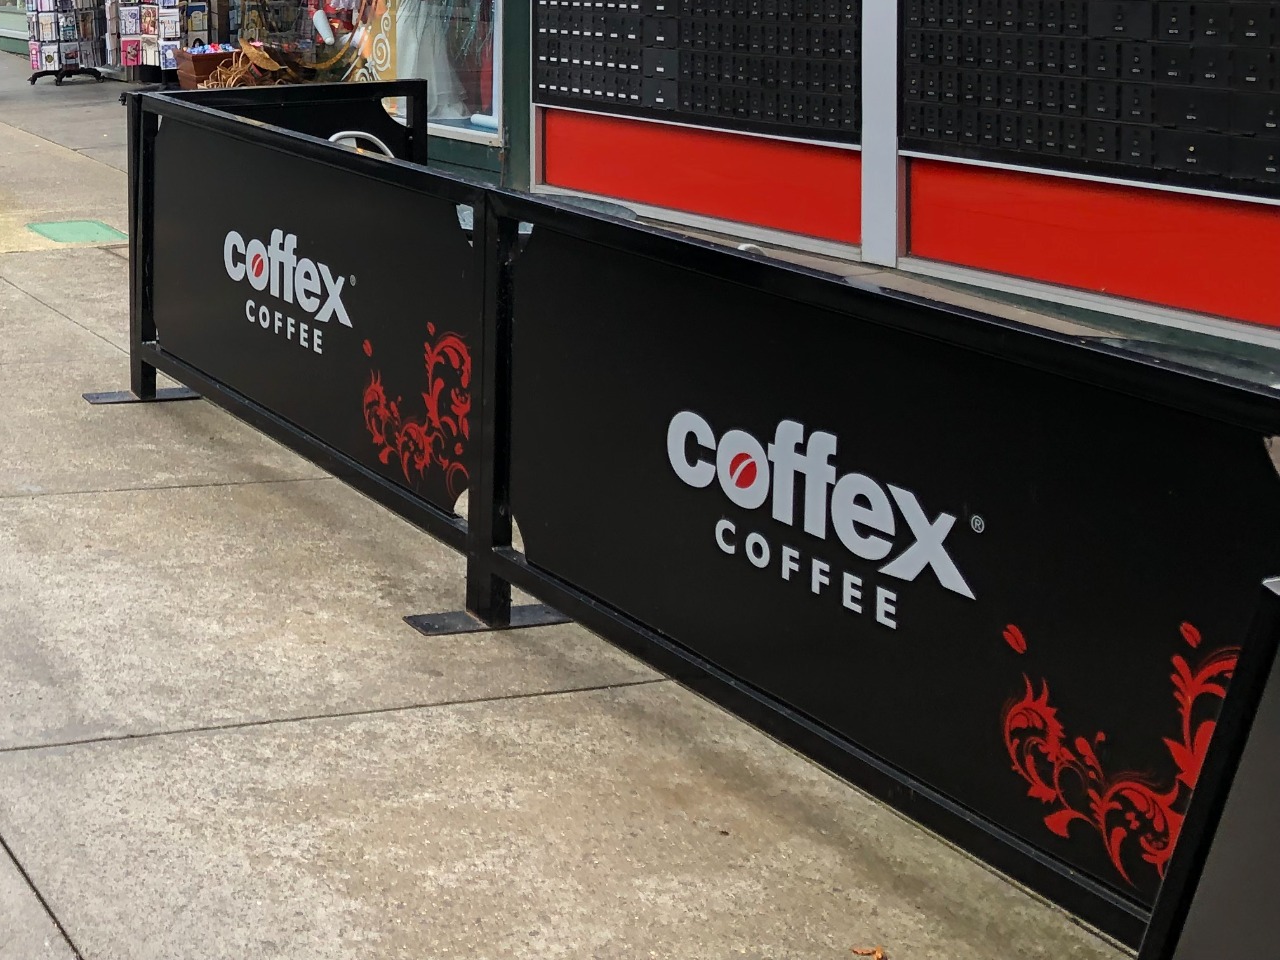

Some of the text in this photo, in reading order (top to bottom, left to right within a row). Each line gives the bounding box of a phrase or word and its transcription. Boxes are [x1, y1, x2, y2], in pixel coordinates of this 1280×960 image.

[224, 228, 353, 328] coffex
[245, 299, 324, 355] COFFEE
[667, 411, 977, 601] coffex
[715, 518, 897, 630] COFFEE
